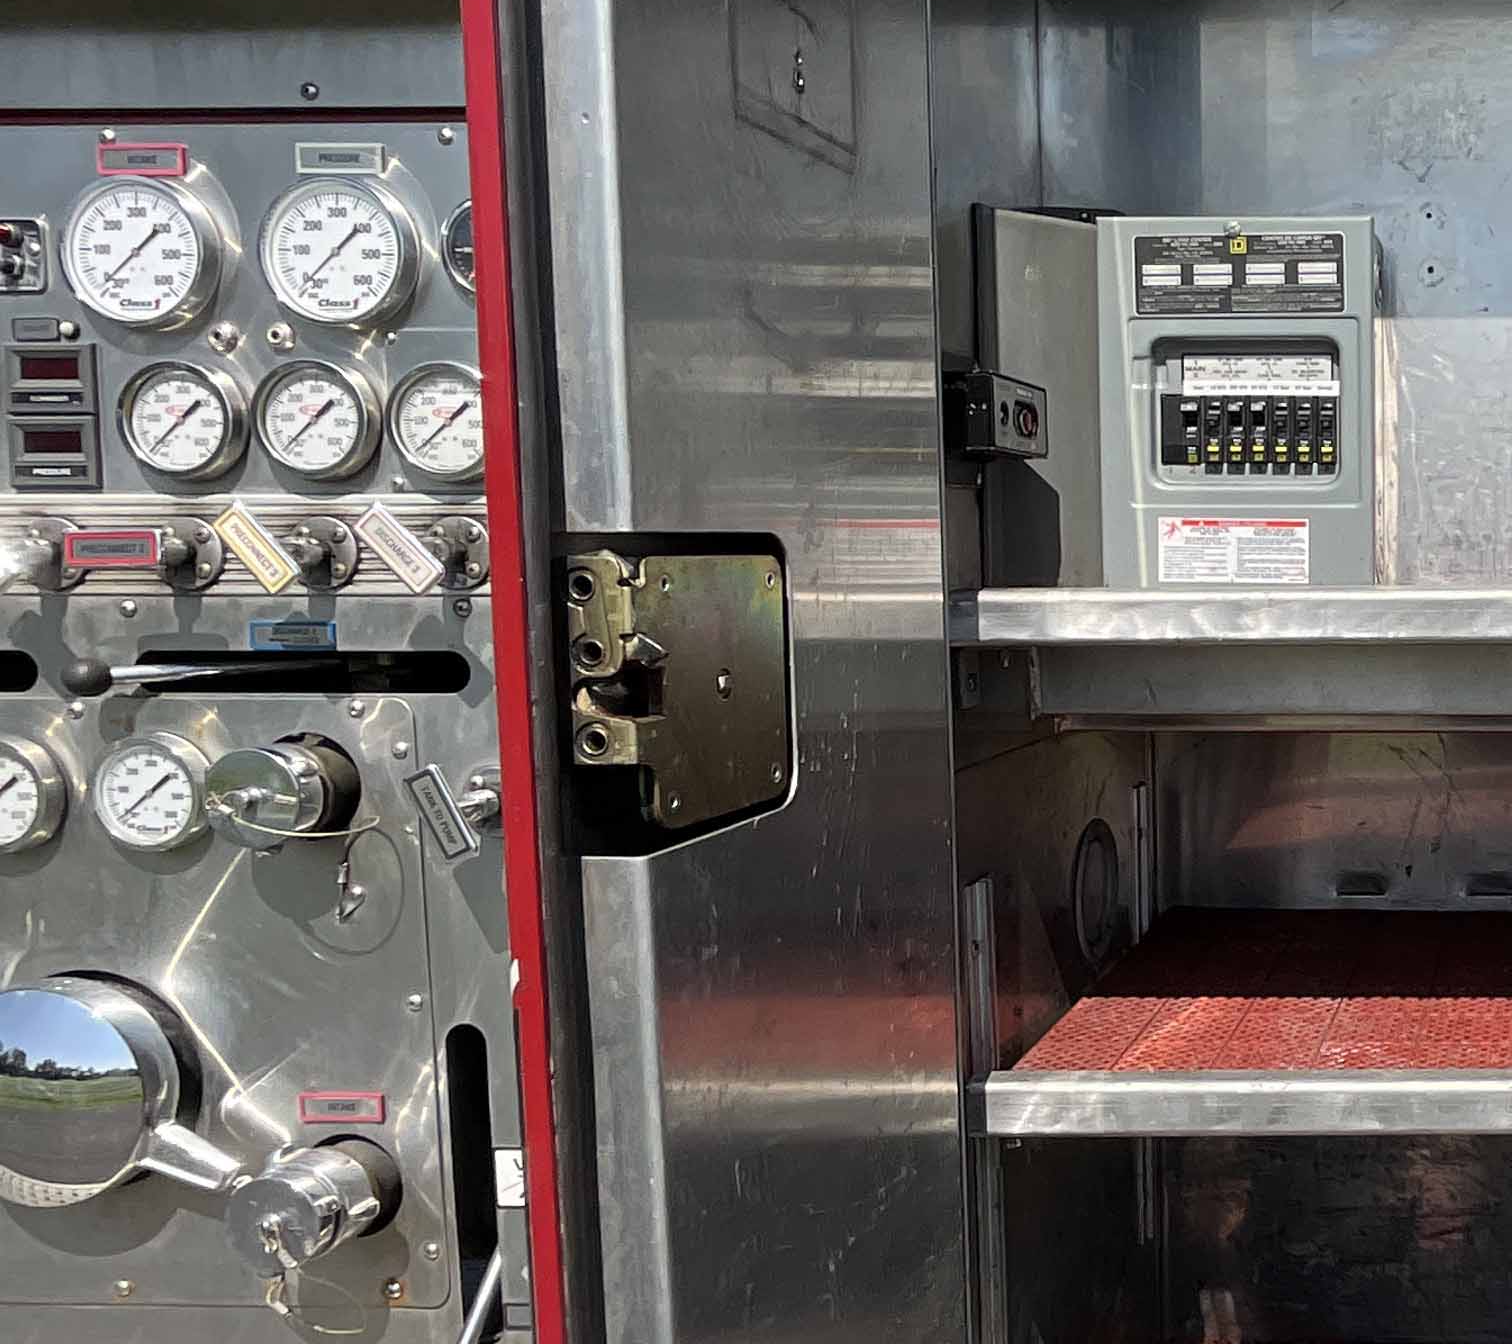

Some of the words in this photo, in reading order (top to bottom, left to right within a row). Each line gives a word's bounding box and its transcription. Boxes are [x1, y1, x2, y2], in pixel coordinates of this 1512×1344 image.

[127, 207, 147, 219] 300
[327, 207, 347, 218] 300
[103, 219, 122, 231] 200
[303, 220, 323, 231] 200
[93, 244, 111, 254] 100
[161, 249, 181, 260] 500
[293, 244, 310, 255] 100
[361, 249, 380, 259] 500
[154, 275, 173, 286] 600
[353, 275, 372, 286] 600
